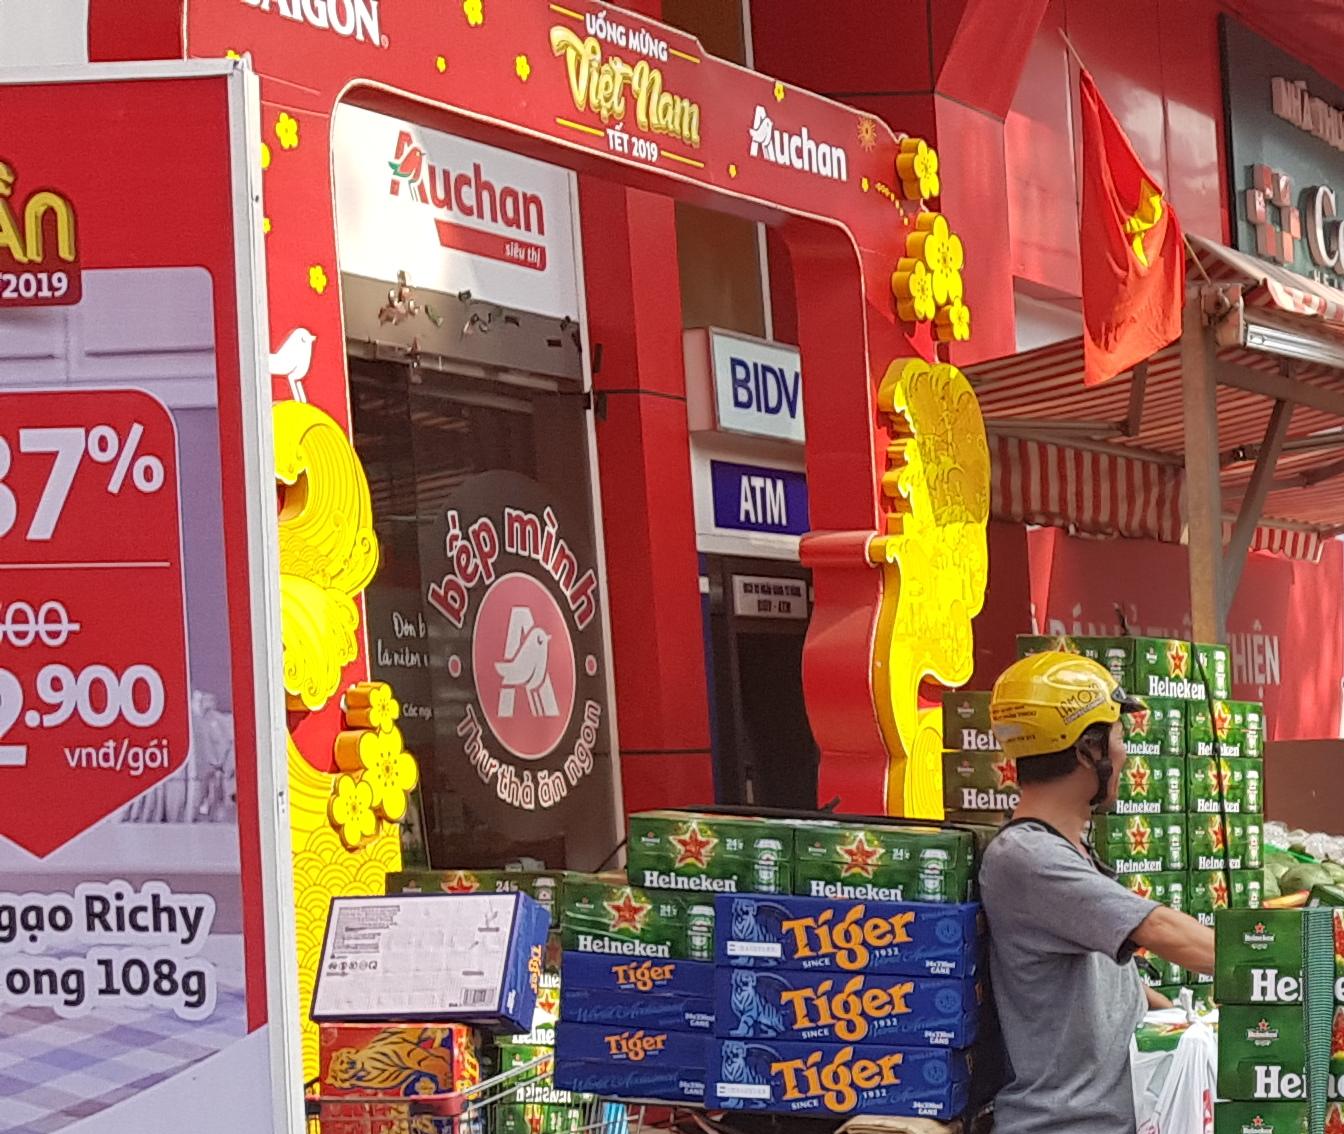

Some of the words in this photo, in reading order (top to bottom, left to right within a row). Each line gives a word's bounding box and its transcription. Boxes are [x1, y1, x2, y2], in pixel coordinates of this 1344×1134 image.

[241, 0, 380, 47] GON
[585, 10, 627, 46] UỐNG
[628, 25, 668, 61] MỪNG
[549, 25, 630, 123] Việt
[631, 60, 701, 148] Nam
[606, 124, 630, 154] TẾT
[631, 136, 658, 162] 2019
[749, 104, 847, 182] Auchan
[387, 129, 546, 237] Auchan
[729, 357, 800, 419] BIDV
[739, 474, 788, 527] ATM
[431, 500, 498, 629] bếp
[503, 504, 598, 631] mình
[0, 599, 80, 648] 00
[1148, 674, 1206, 700] Heineken
[64, 742, 170, 777] vnđ/gói
[564, 700, 601, 786] ngon
[1122, 738, 1161, 756] eineken
[962, 788, 1020, 811] Heine
[1116, 799, 1161, 815] Heineken
[1197, 798, 1241, 814] Heinken
[643, 870, 735, 893] Heineken
[810, 880, 901, 902] Heineken
[1116, 857, 1163, 875] Heineken
[1198, 855, 1242, 872] Heineen
[86, 893, 205, 944] Richy
[781, 904, 916, 971] Tiger
[578, 935, 668, 959] Heineken
[803, 957, 831, 969] SINCE
[874, 946, 900, 958] 1932
[98, 959, 208, 1006] 108g
[611, 960, 676, 992] Tiger
[780, 974, 915, 1042] Tiger
[802, 1027, 830, 1040] SINCE
[873, 1017, 898, 1029] 1932
[604, 1029, 668, 1062] Tiger
[770, 1046, 904, 1113] Tiger
[791, 1098, 819, 1111] SINCE
[862, 1088, 887, 1099] 1932
